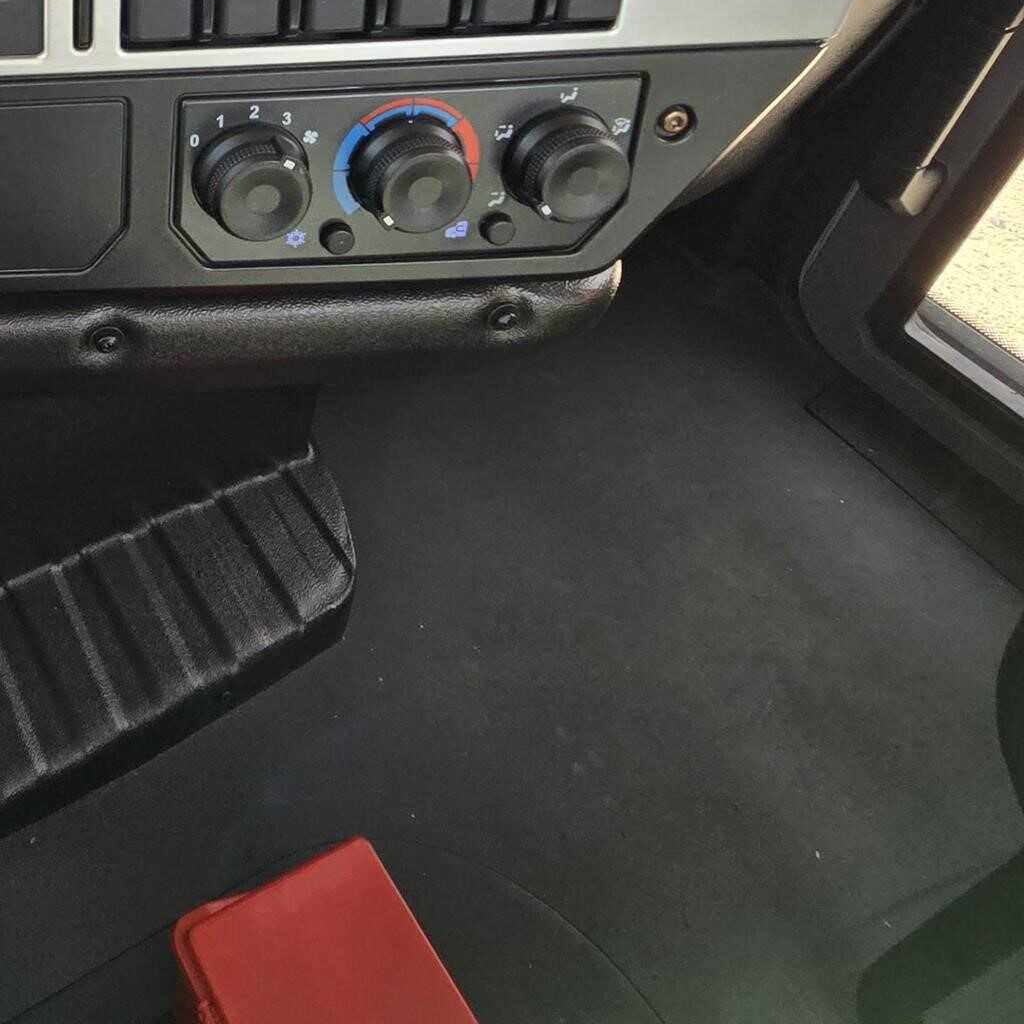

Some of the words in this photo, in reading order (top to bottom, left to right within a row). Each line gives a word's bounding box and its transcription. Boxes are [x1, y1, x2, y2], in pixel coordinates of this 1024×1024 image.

[249, 105, 260, 119] 2
[282, 111, 292, 125] 3
[216, 114, 224, 128] 1
[189, 134, 199, 147] 0
